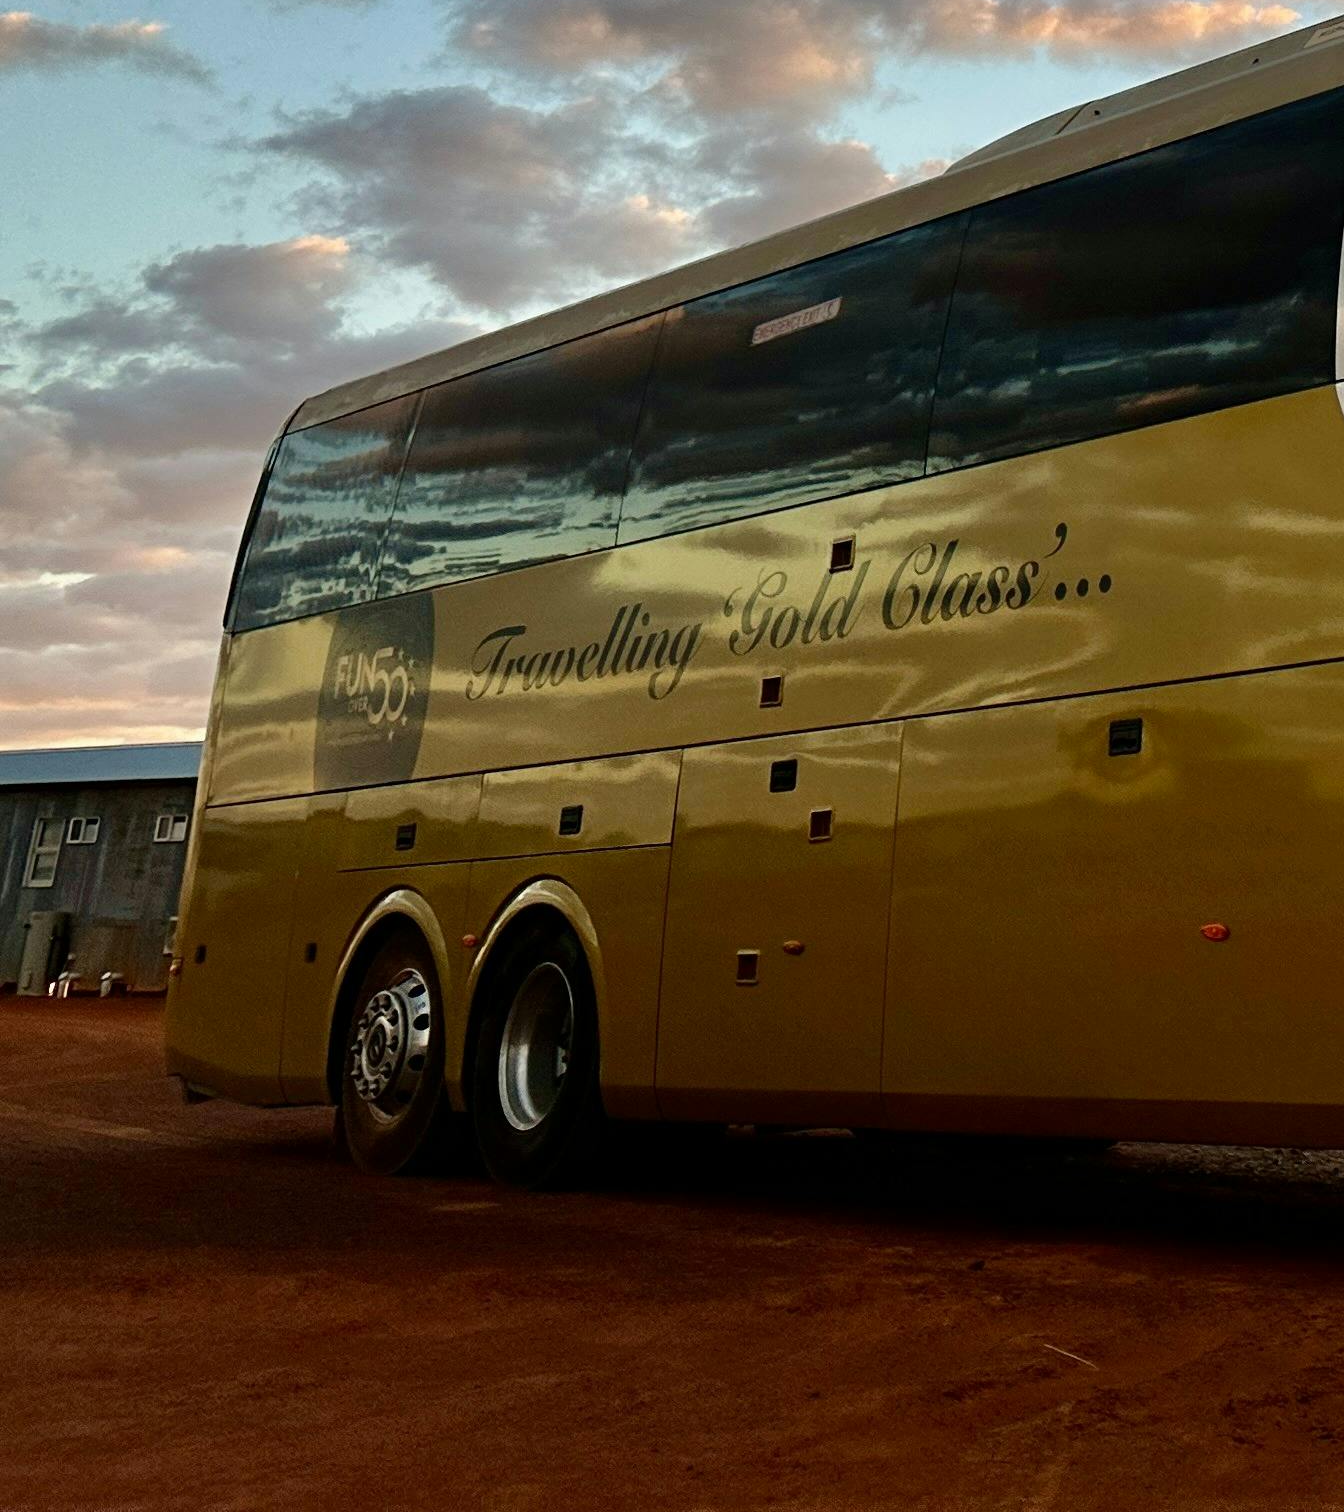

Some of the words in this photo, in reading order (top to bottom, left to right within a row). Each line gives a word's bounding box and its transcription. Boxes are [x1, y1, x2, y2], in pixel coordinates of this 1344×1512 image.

[334, 652, 376, 699] FUN
[368, 646, 408, 724] 50
[465, 602, 703, 700] Travelling
